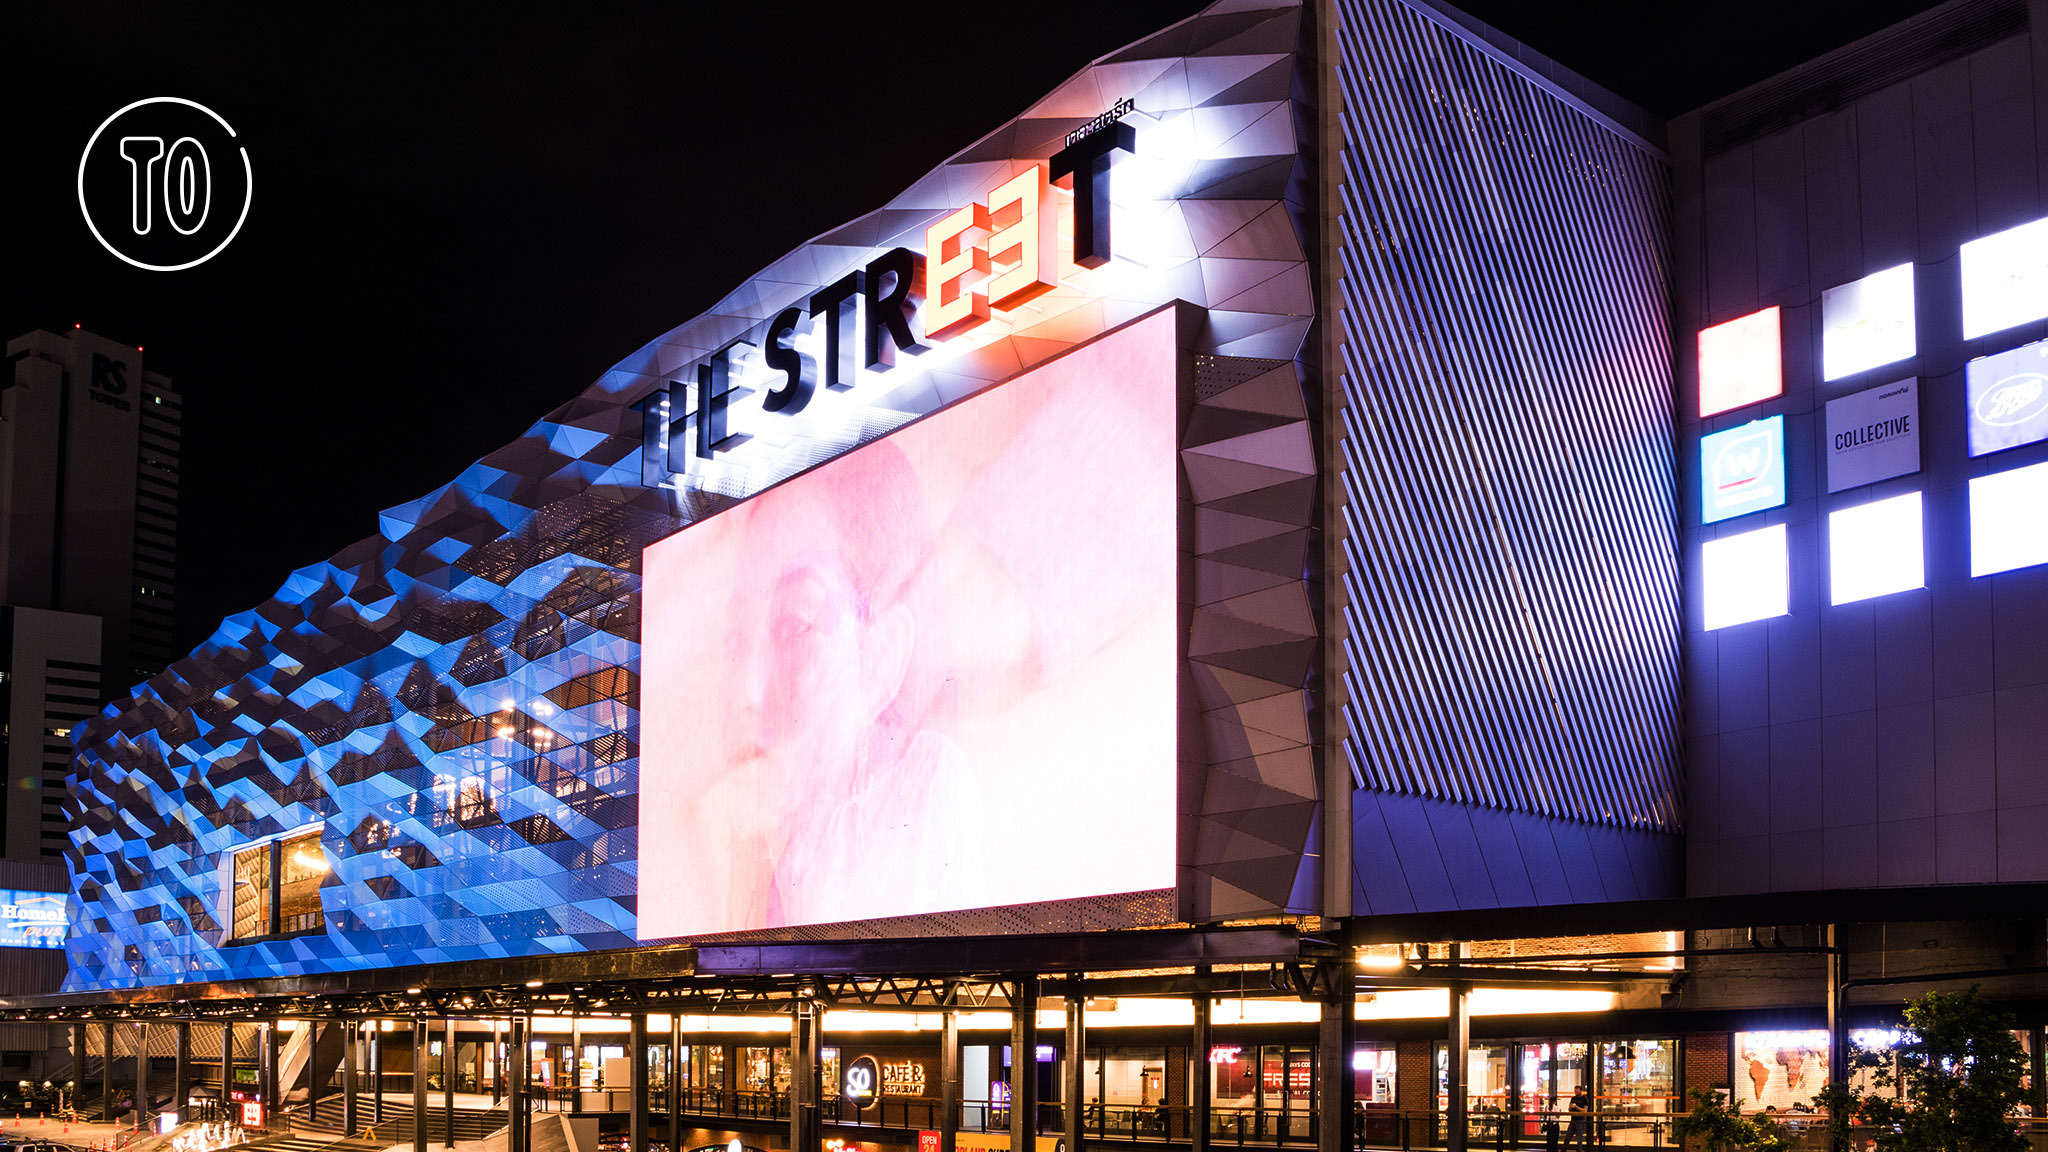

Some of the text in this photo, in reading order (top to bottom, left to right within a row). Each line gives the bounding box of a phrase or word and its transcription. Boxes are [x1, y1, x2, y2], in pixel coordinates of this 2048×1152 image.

[630, 121, 1136, 488] THE STREET
[1835, 415, 1910, 450] COLLECTIVE
[1, 904, 67, 921] HomeP
[1209, 1047, 1239, 1063] KFC
[1263, 1072, 1320, 1086] FRES
[922, 1135, 937, 1145] OPEN
